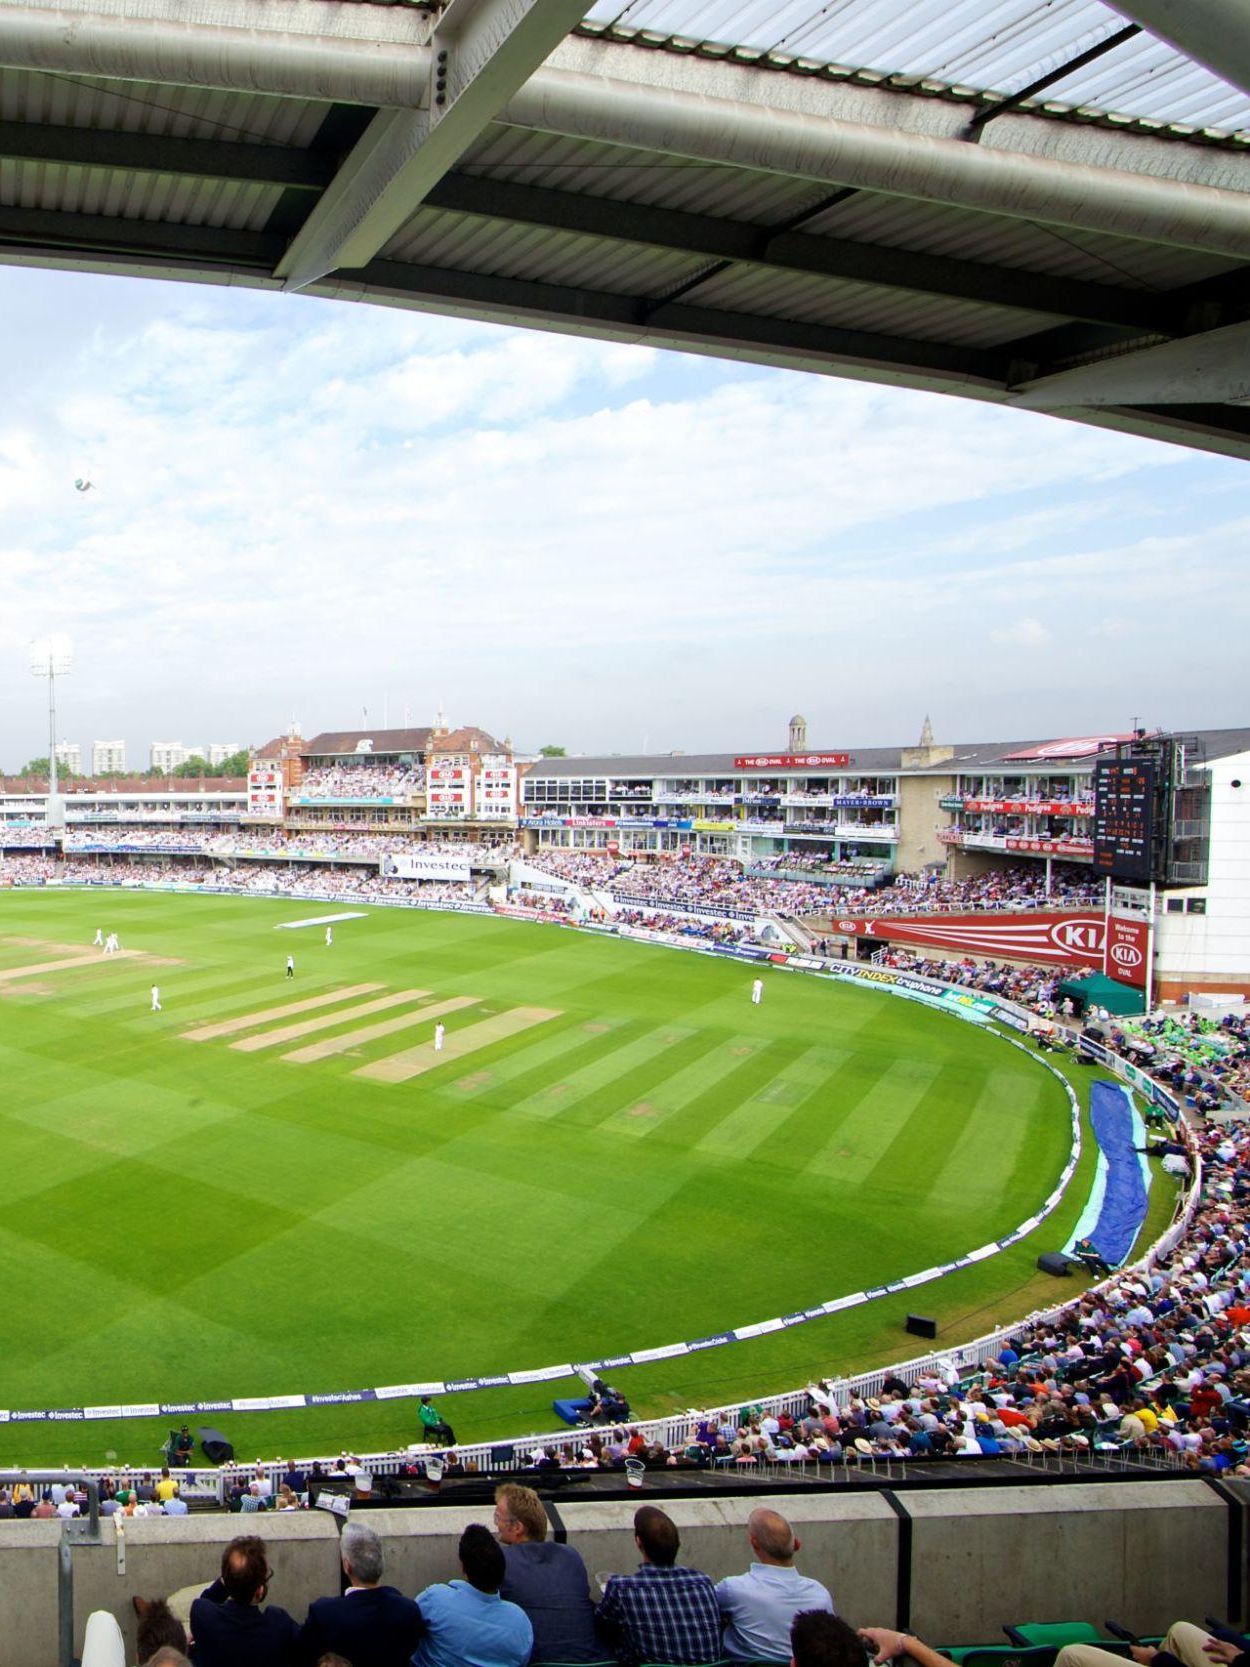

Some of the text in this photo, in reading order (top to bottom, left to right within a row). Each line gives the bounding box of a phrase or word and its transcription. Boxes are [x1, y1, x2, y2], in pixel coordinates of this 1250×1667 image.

[980, 803, 1003, 812] Pedigree
[1025, 804, 1051, 813] Pedigree
[410, 859, 467, 872] Investec
[335, 894, 495, 913] Investec Investec Investec Investec
[620, 895, 648, 906] Investec
[656, 899, 686, 912] Investec
[694, 903, 726, 918] Investec
[1114, 923, 1139, 935] Welcome
[1118, 934, 1135, 943] to the
[1116, 947, 1137, 963] KIA
[1118, 969, 1132, 978] OVAL
[897, 976, 942, 995] truphone
[167, 1403, 196, 1413] Investec
[203, 1401, 232, 1411] Investec
[16, 1411, 45, 1420] Investec
[54, 1411, 83, 1420] Investec
